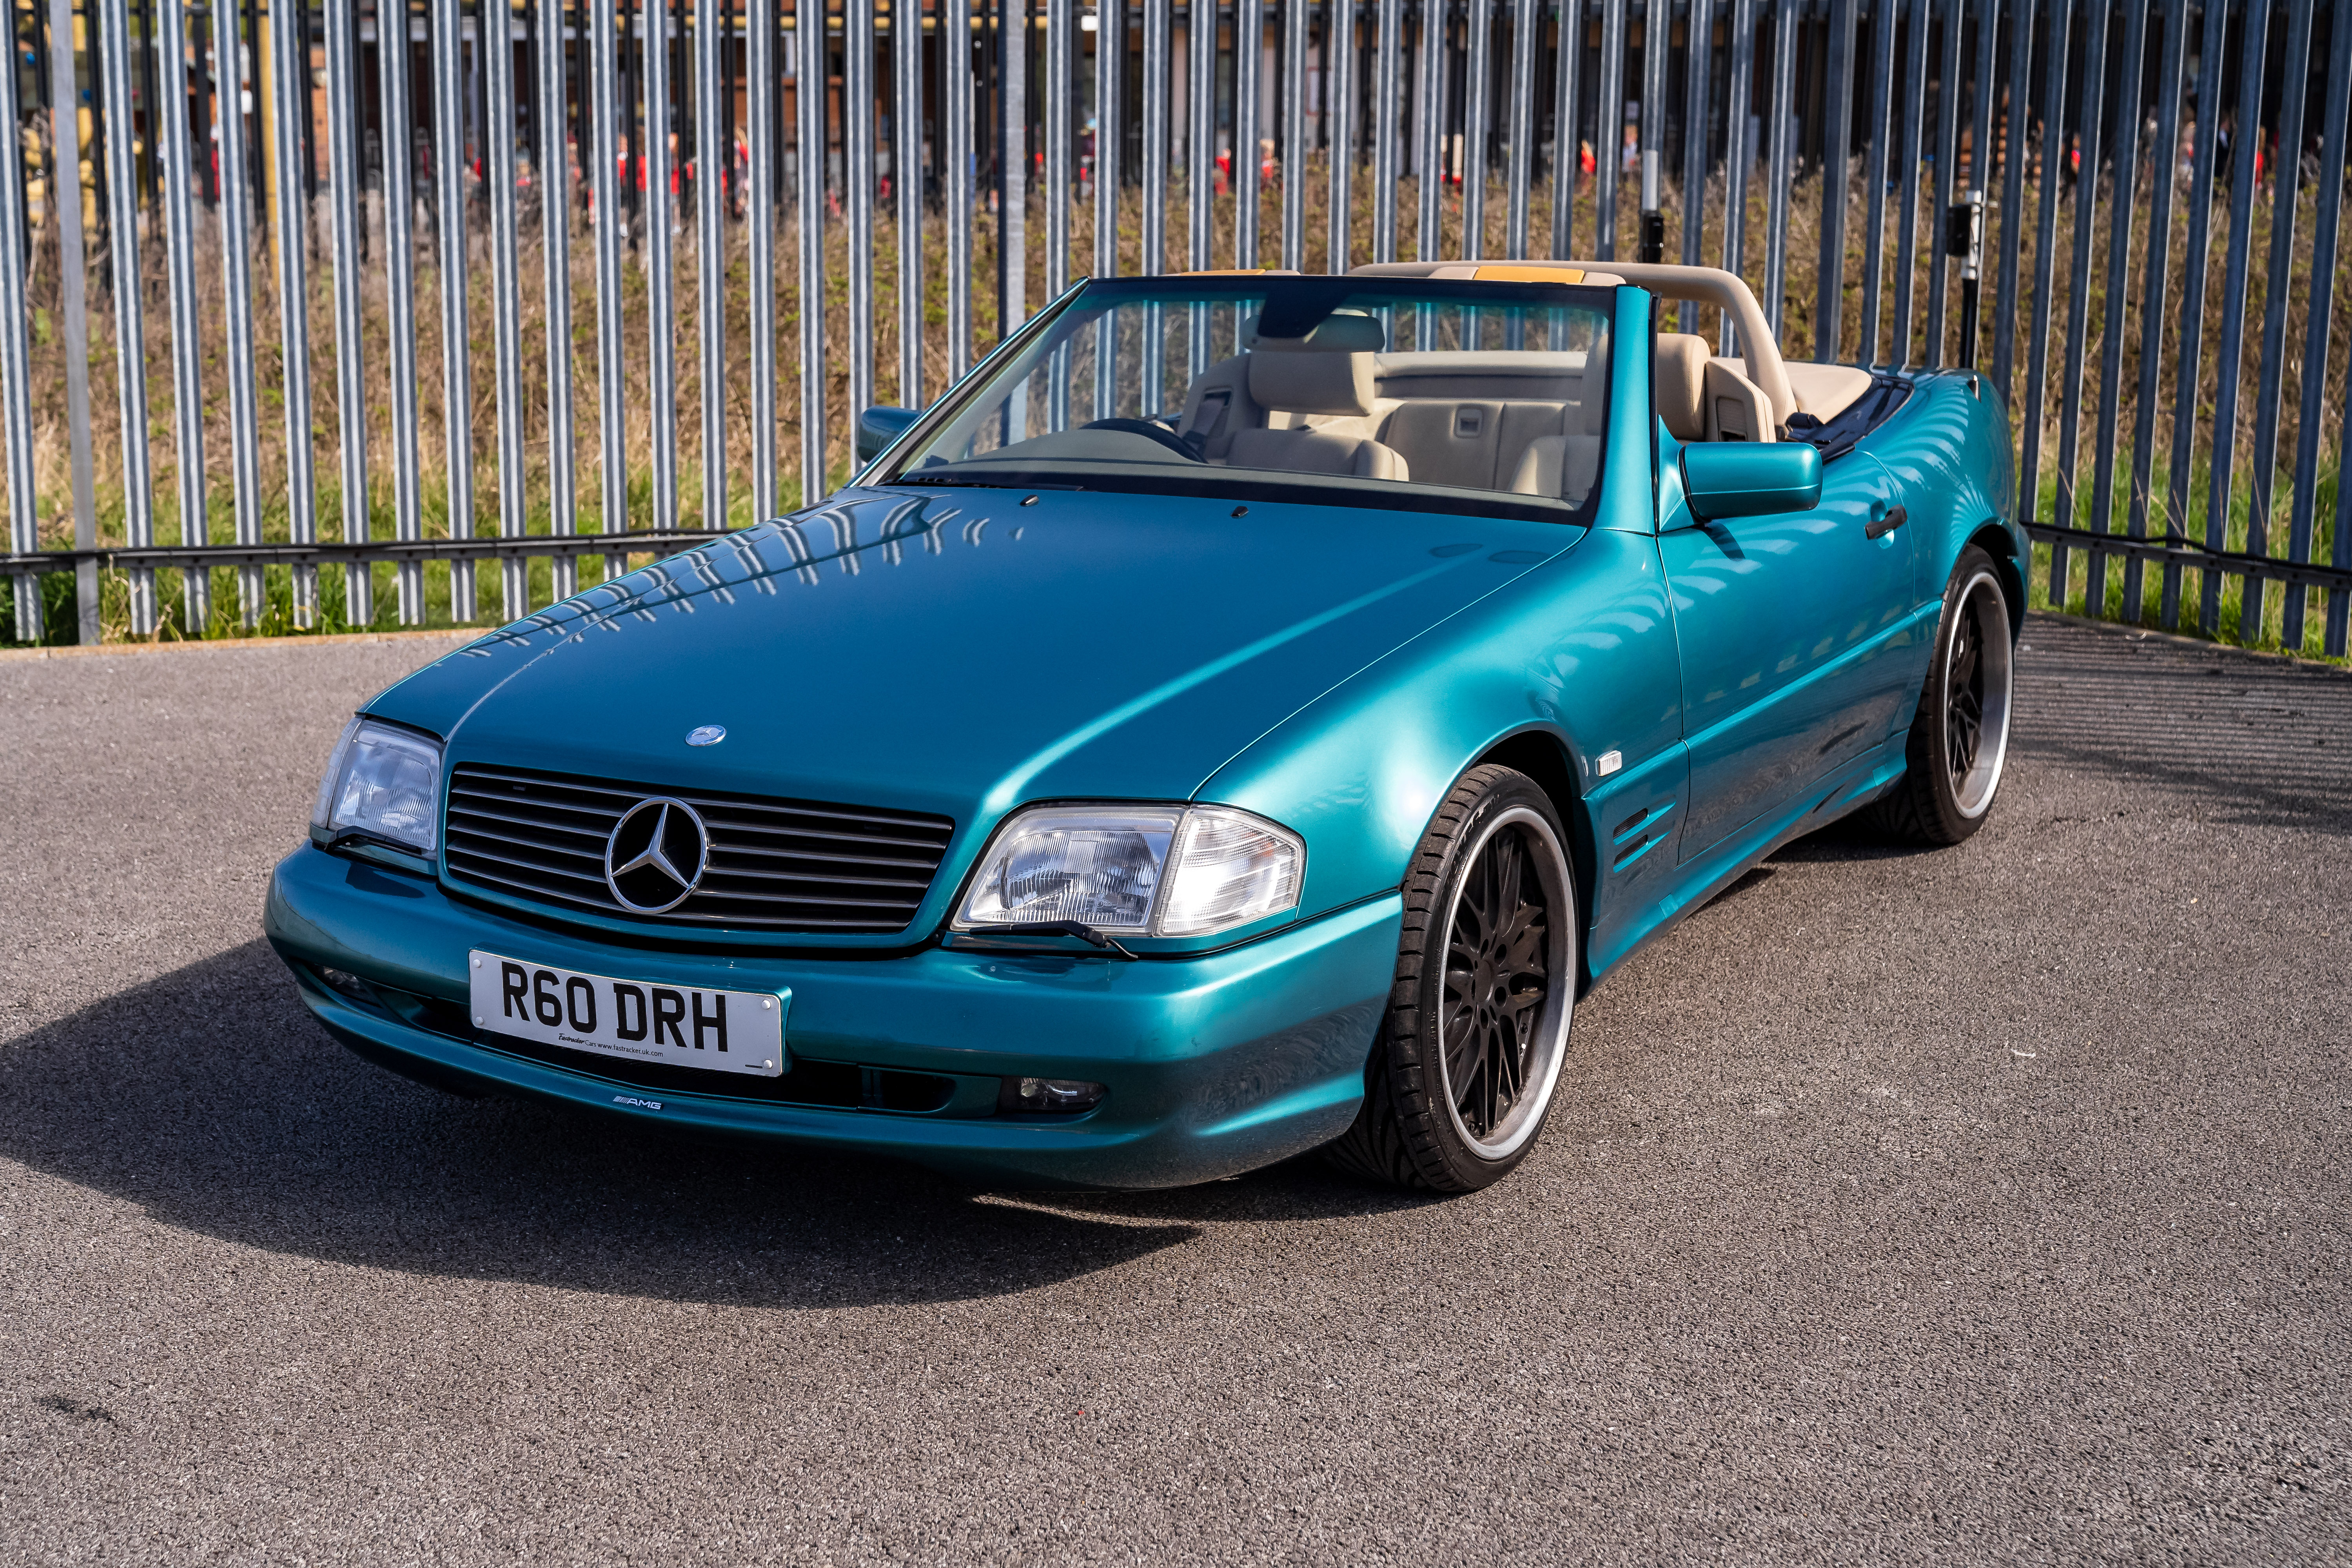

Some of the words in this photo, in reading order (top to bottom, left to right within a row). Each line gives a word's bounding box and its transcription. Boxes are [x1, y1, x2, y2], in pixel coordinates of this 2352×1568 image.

[501, 961, 597, 1034] R60
[613, 982, 728, 1053] DRH
[558, 1033, 584, 1044] Fastracker
[597, 1043, 663, 1057] www.fastracker.uk.com
[626, 1098, 662, 1109] AMG
